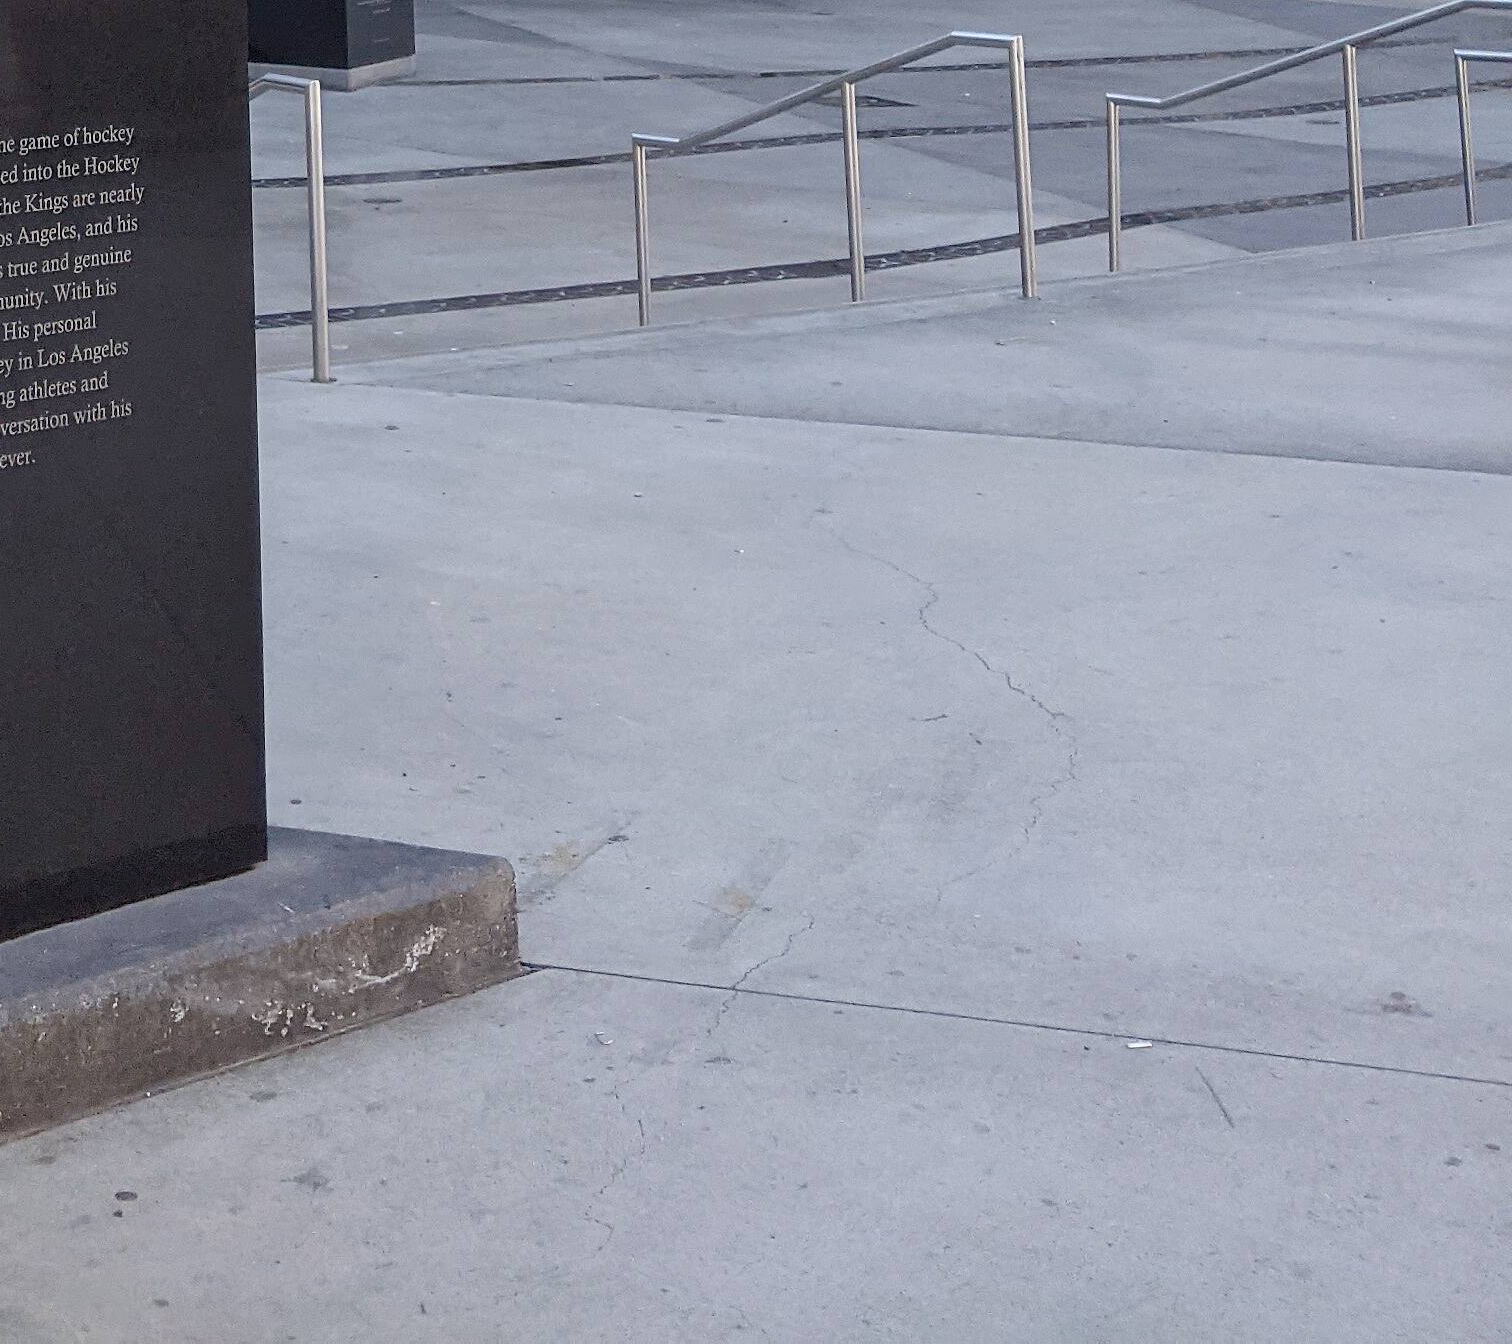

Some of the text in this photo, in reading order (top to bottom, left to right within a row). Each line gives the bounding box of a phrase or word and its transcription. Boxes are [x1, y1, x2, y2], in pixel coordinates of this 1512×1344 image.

[18, 134, 60, 156] game
[63, 126, 81, 147] of
[81, 124, 135, 146] hockey
[24, 191, 69, 215] Kings
[72, 192, 96, 208] are
[98, 181, 145, 206] nearly
[7, 260, 38, 278] true
[41, 251, 70, 274] and
[73, 245, 132, 274] genuine
[19, 378, 77, 402] athletes
[80, 369, 109, 393] and
[72, 401, 107, 425] with
[109, 398, 132, 419] his
